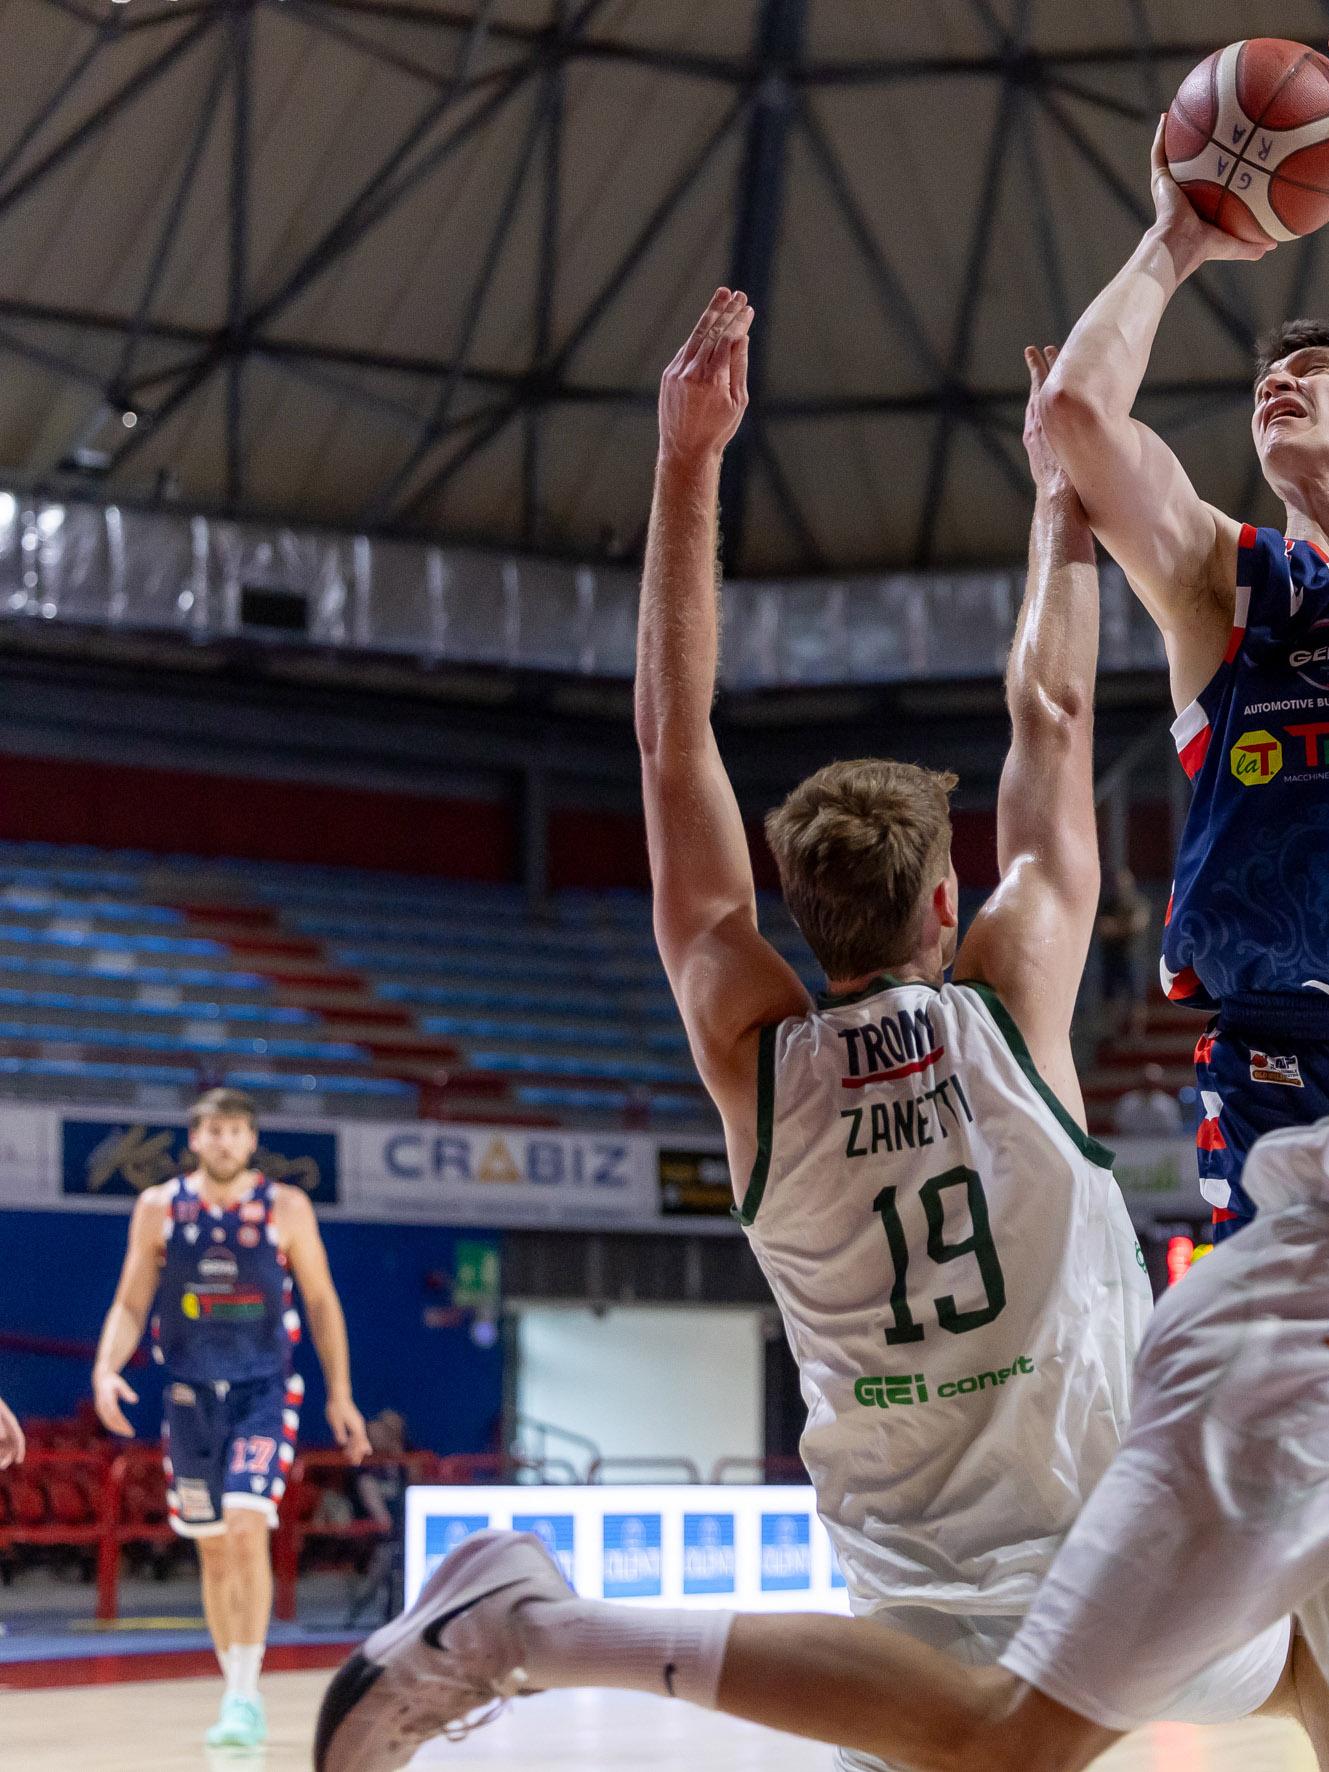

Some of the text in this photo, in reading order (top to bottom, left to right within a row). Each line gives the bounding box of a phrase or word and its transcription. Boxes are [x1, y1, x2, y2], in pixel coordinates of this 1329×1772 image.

[1244, 698, 1314, 715] AUTOMOTIVE
[1283, 771, 1329, 783] MACCHINE
[840, 1073, 974, 1159] ZANETTI
[383, 1133, 628, 1187] CRABIZ
[872, 1164, 1007, 1346] 19
[230, 1434, 278, 1475] 17
